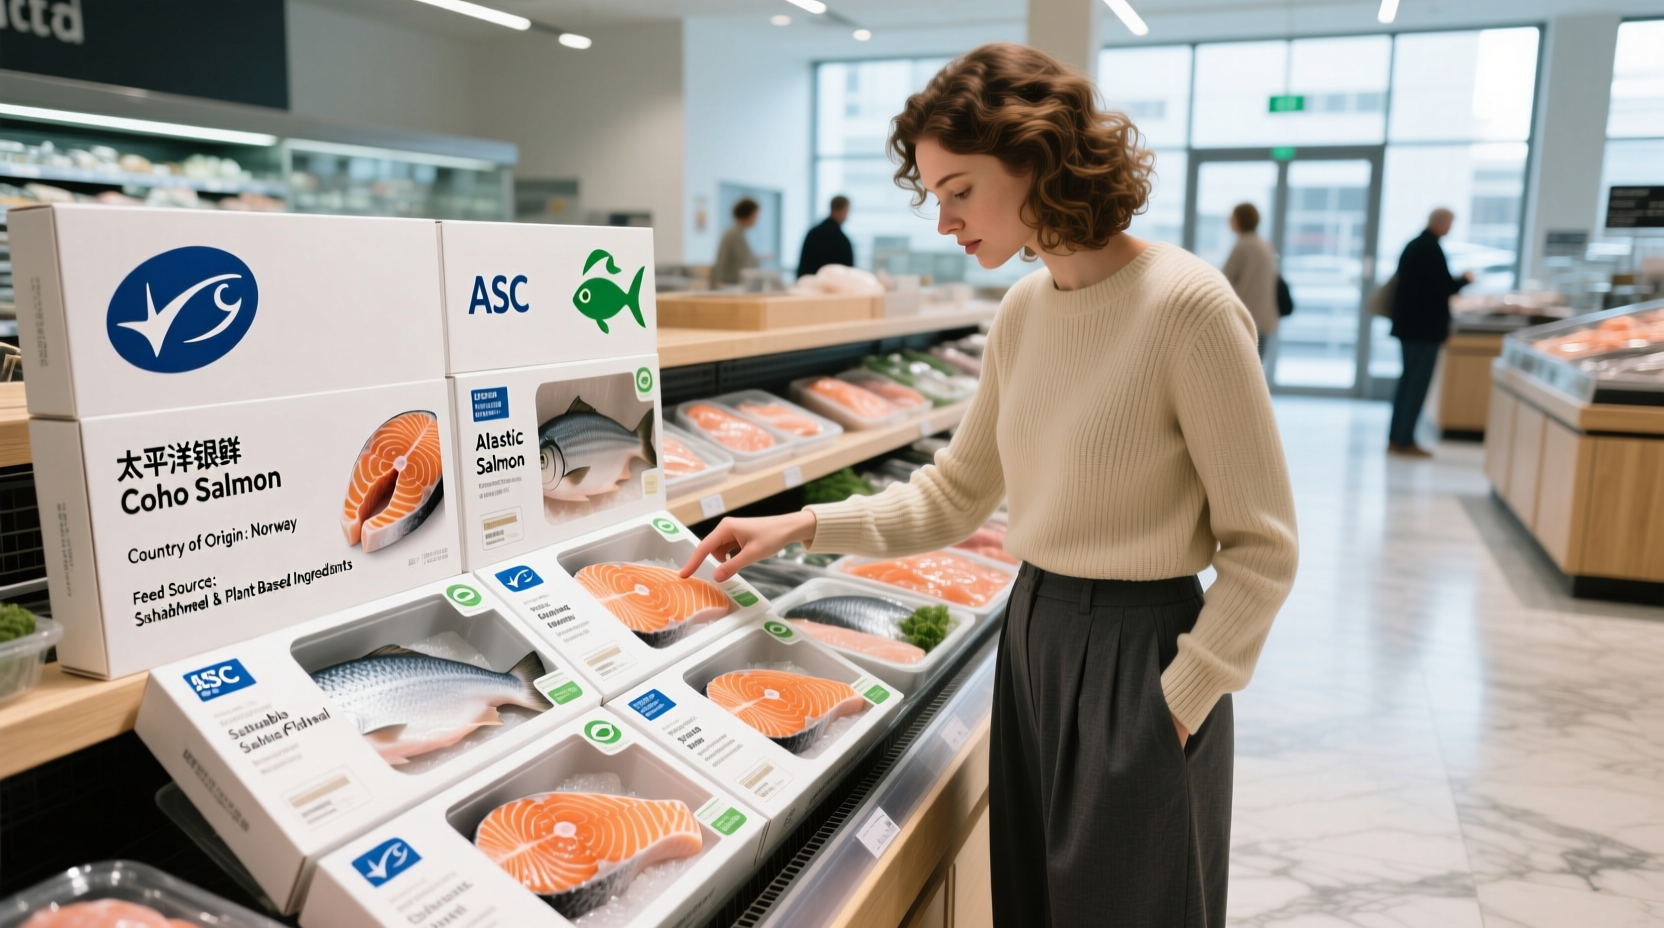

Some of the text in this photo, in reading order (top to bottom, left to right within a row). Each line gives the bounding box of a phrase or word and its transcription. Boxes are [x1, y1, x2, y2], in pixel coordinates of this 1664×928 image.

[468, 274, 530, 315] ASC
[476, 454, 525, 475] Salmon
[121, 470, 282, 515] Coho Salmon
[127, 541, 185, 564] Country
[188, 534, 202, 552] of
[250, 518, 297, 538] Norway
[132, 575, 217, 606] Feed Source:
[213, 592, 222, 606] &
[225, 582, 256, 603] Plant
